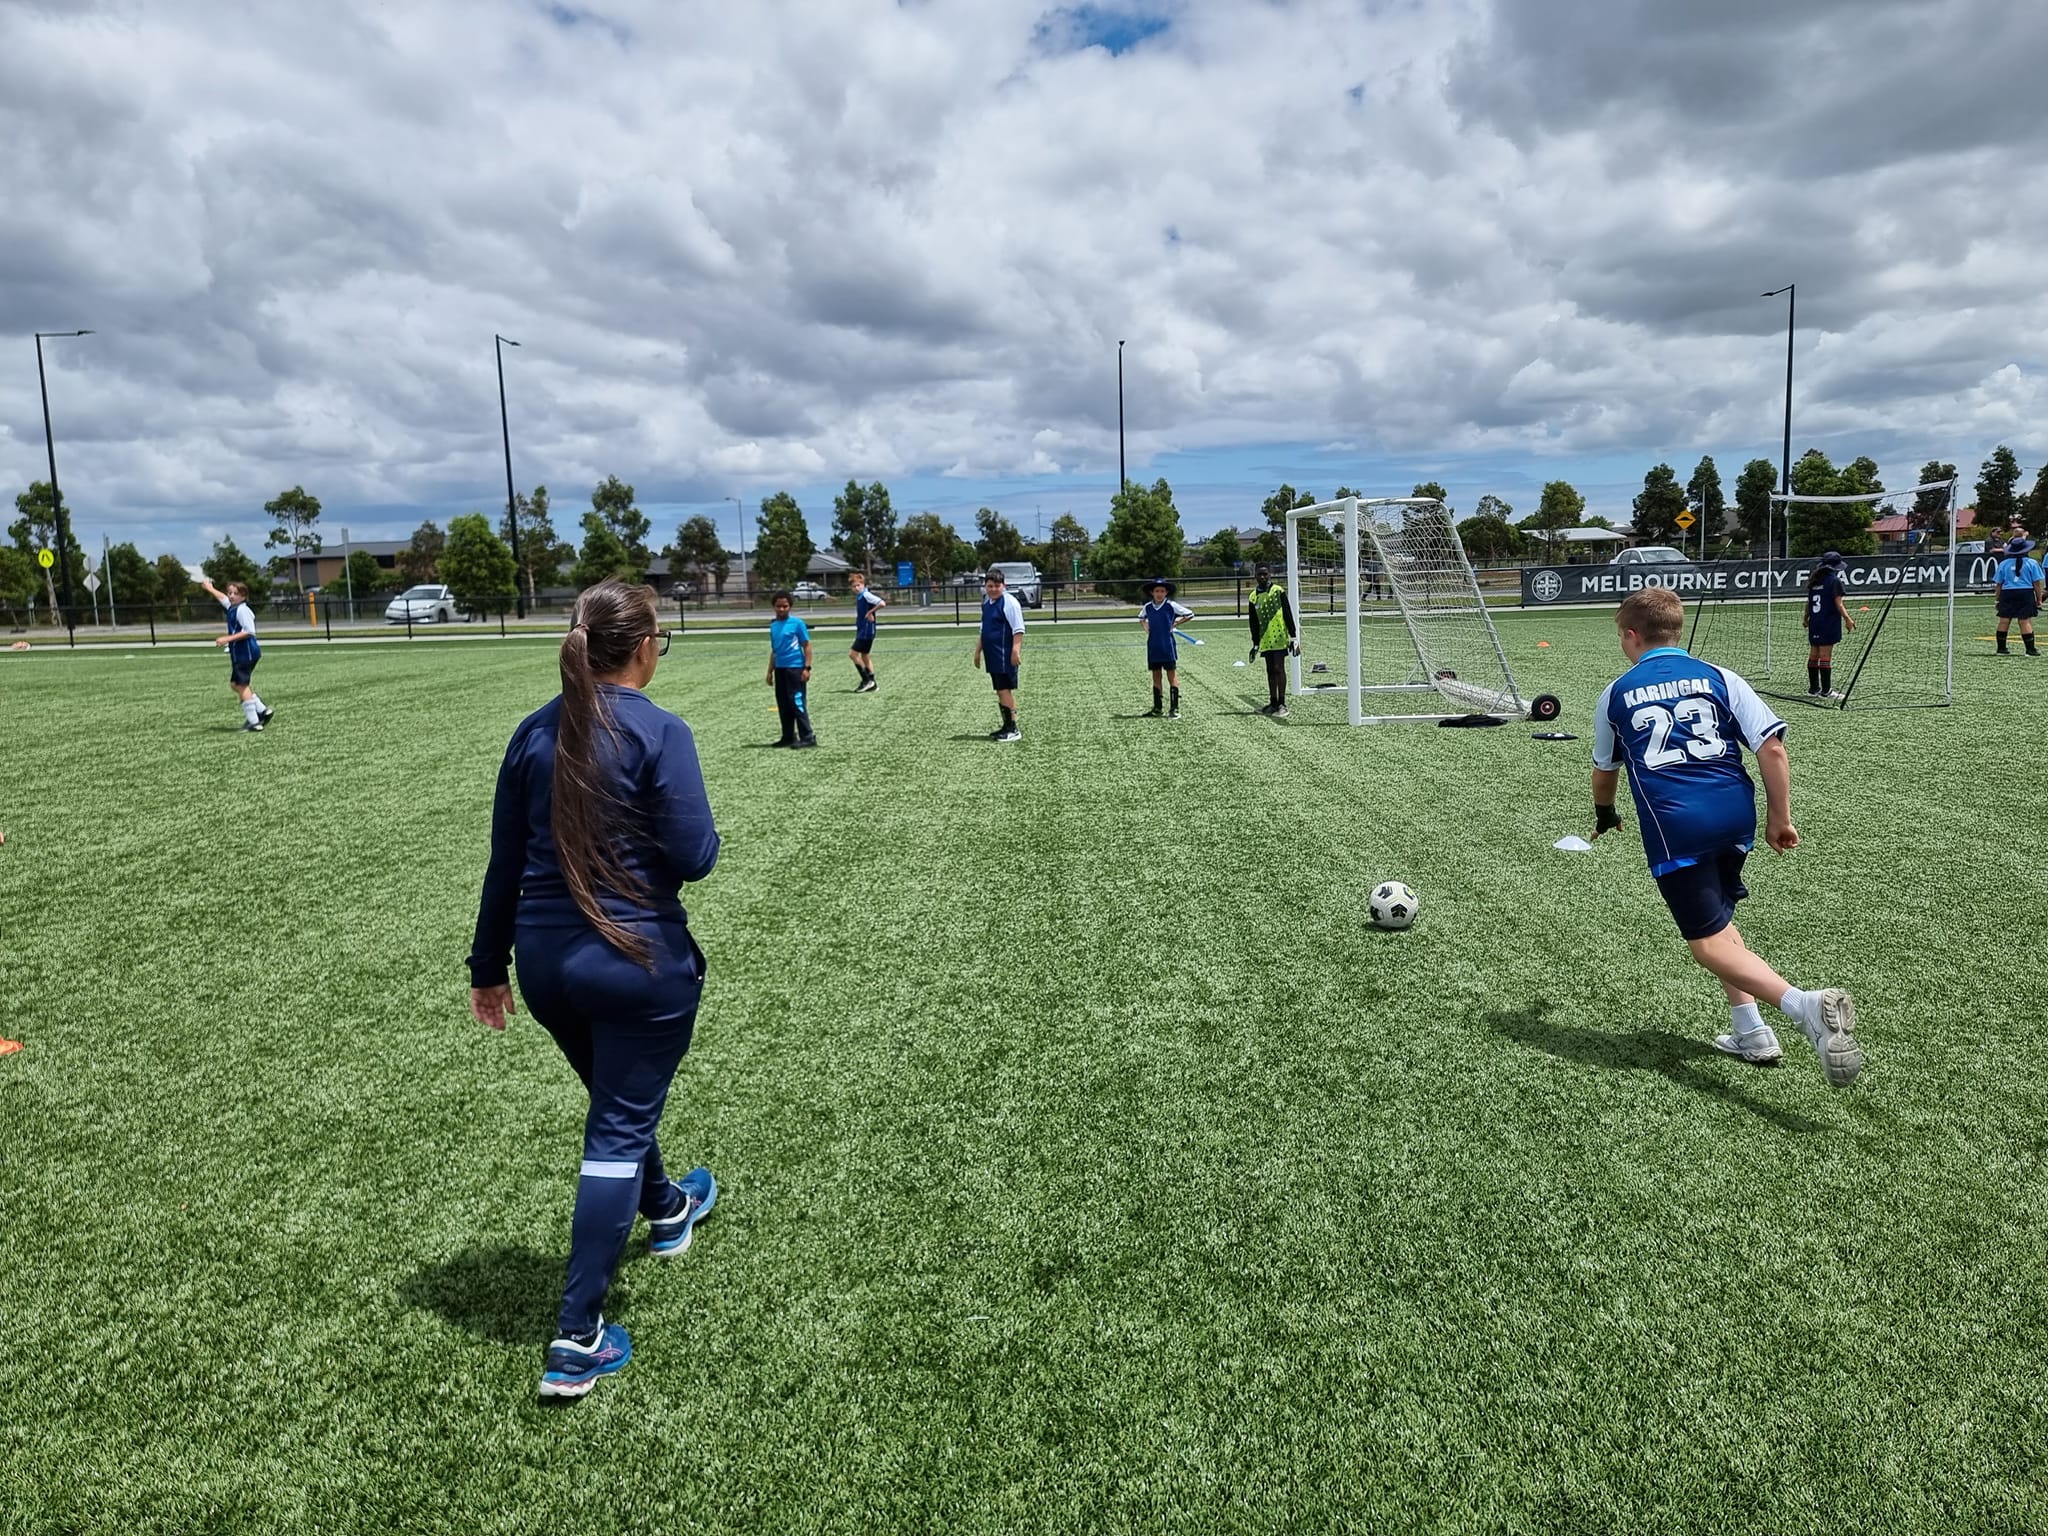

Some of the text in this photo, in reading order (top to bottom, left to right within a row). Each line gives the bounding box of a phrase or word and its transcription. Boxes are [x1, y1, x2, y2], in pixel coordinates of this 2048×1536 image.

[1581, 572, 1727, 593] MELBOURNE
[1734, 570, 1788, 588] CITY
[1836, 566, 1950, 586] ACADEMY
[1812, 594, 1821, 613] 3
[1623, 678, 1713, 708] KARINGAL
[1631, 697, 1727, 770] 23
